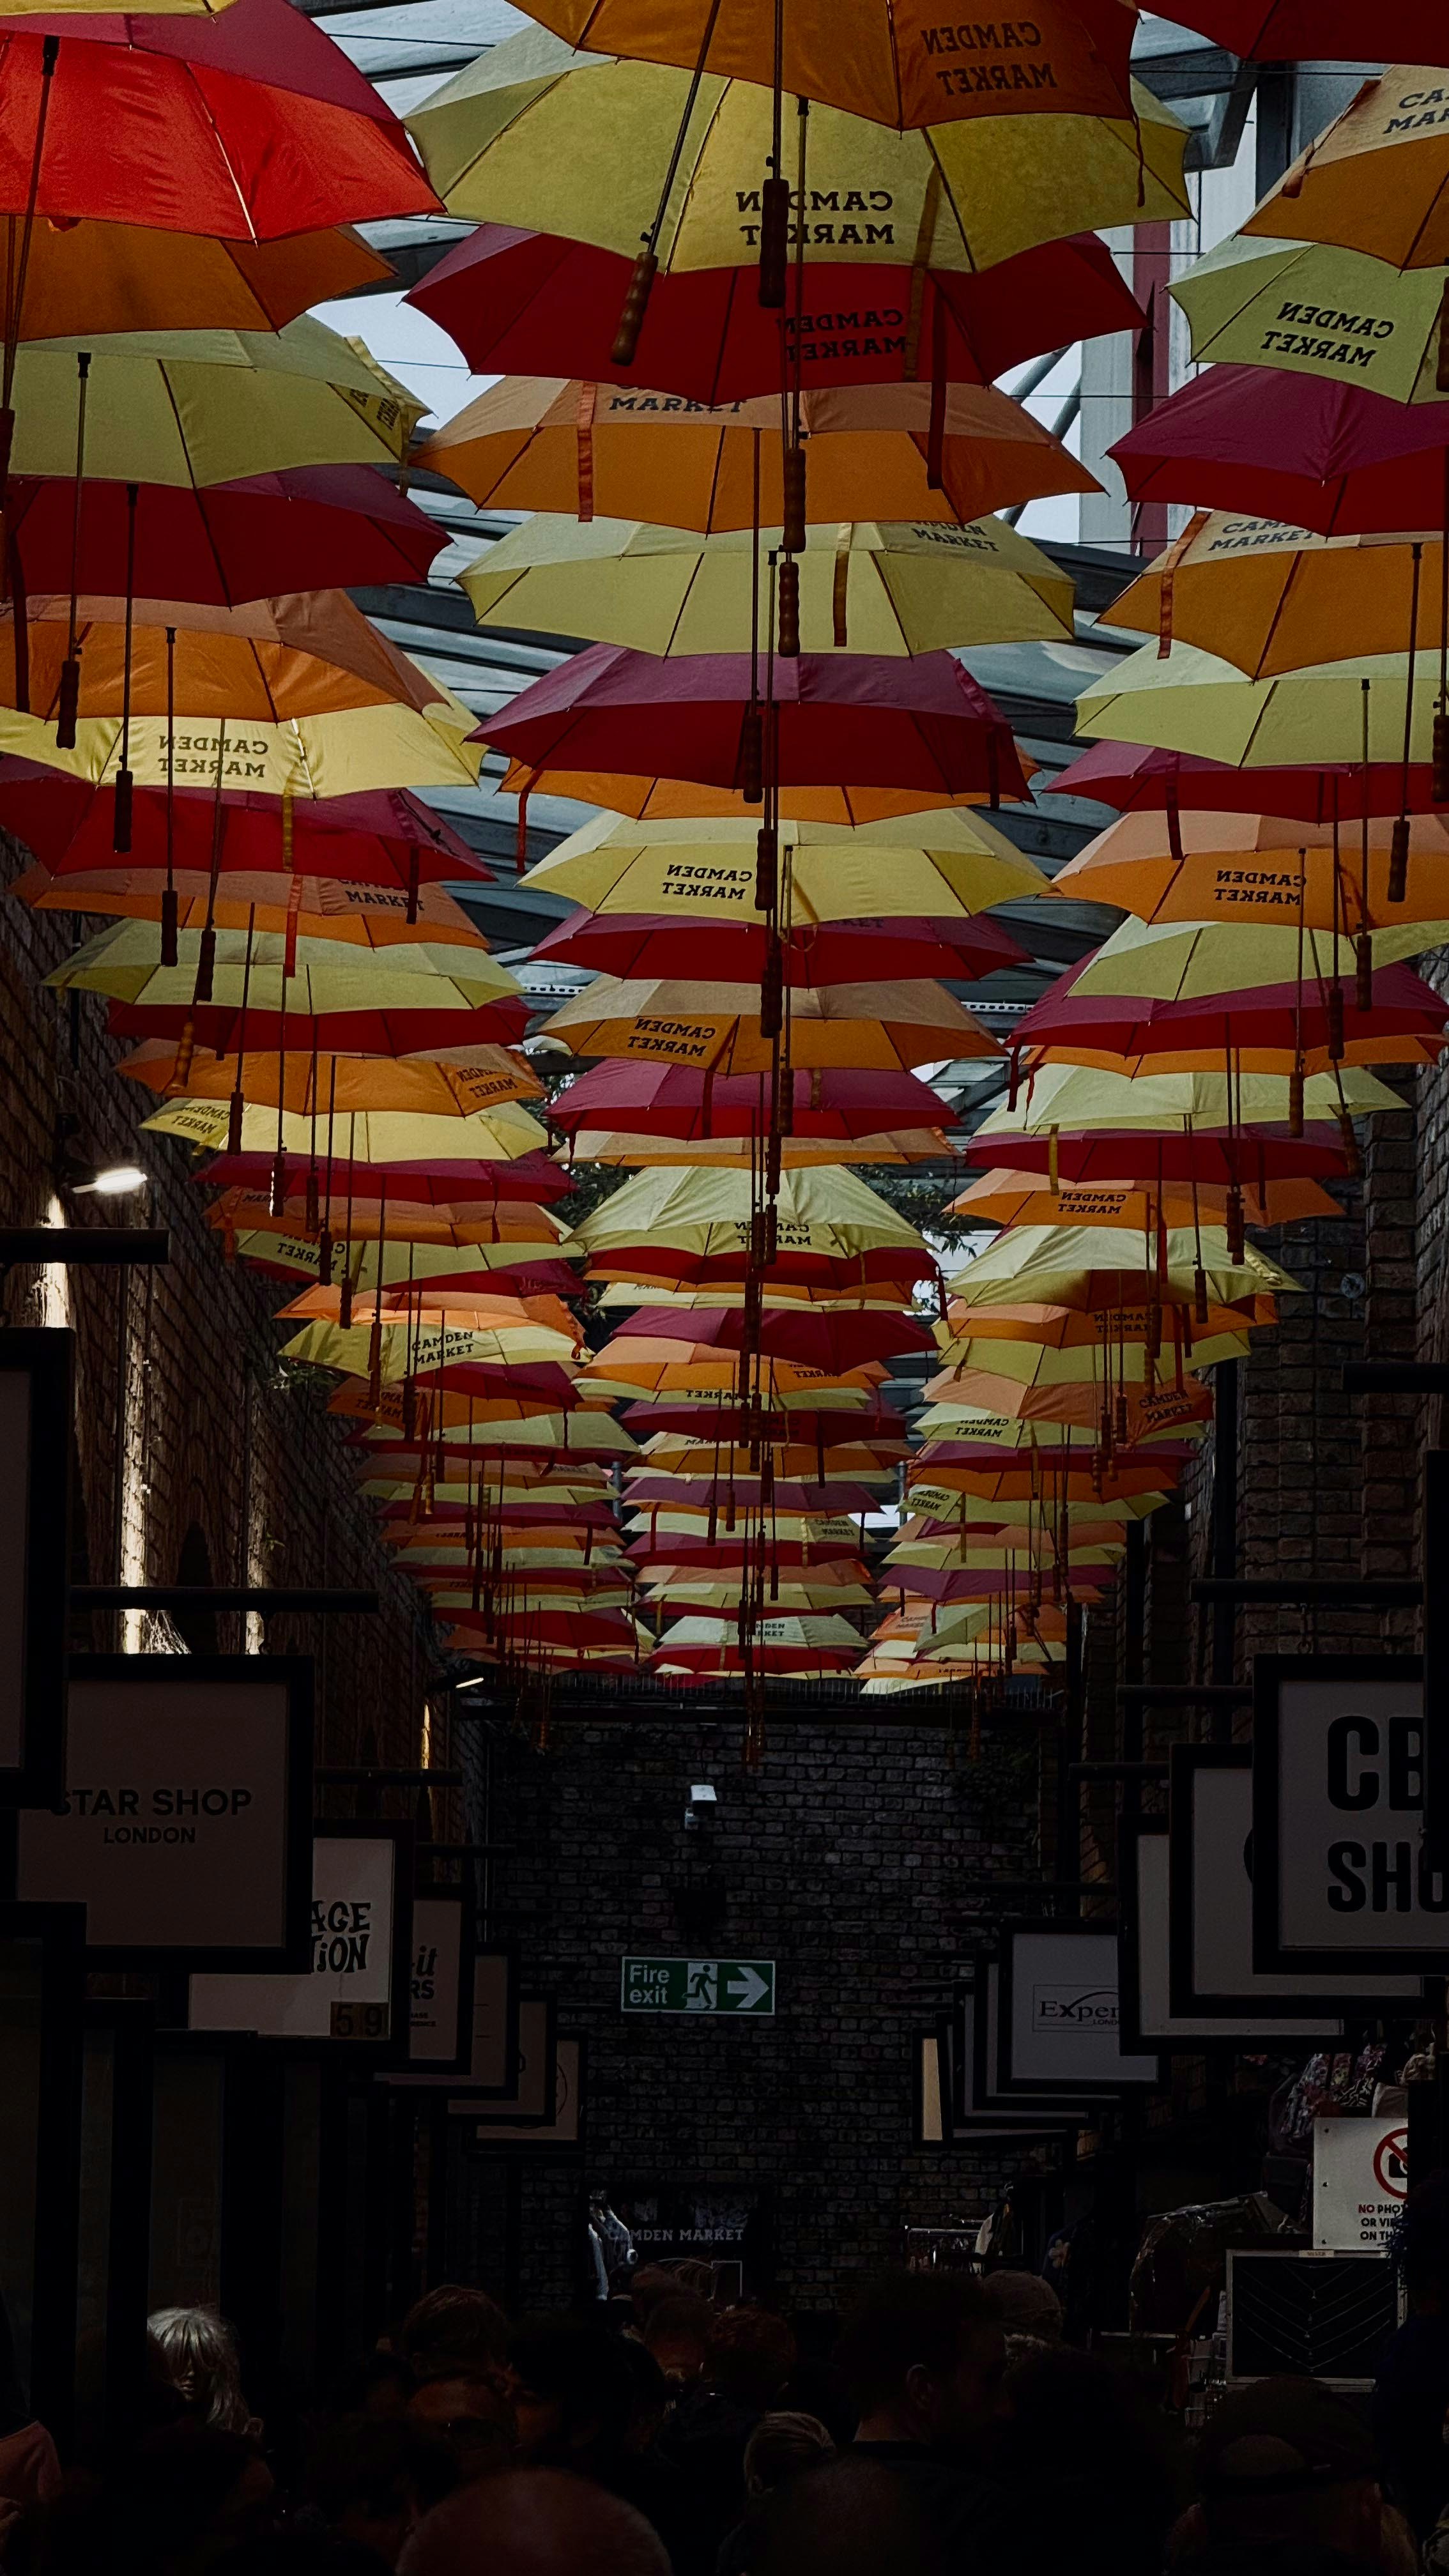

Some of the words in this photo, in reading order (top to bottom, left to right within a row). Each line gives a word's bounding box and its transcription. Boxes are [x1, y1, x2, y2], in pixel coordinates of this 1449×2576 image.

[610, 397, 745, 413] MARKT
[911, 528, 1000, 552] MARKET
[411, 1331, 474, 1352] CAMDEN
[413, 1343, 475, 1365] MARKET
[152, 1788, 252, 1816] SHOP
[103, 1827, 196, 1844] LONDON
[630, 1964, 670, 1984] Fire
[630, 1986, 668, 2004] exit
[1358, 2204, 1375, 2213] NO
[1361, 2218, 1377, 2227] OR
[1379, 2218, 1393, 2227] VI
[678, 2228, 744, 2242] MARKET
[1360, 2230, 1377, 2240] ON
